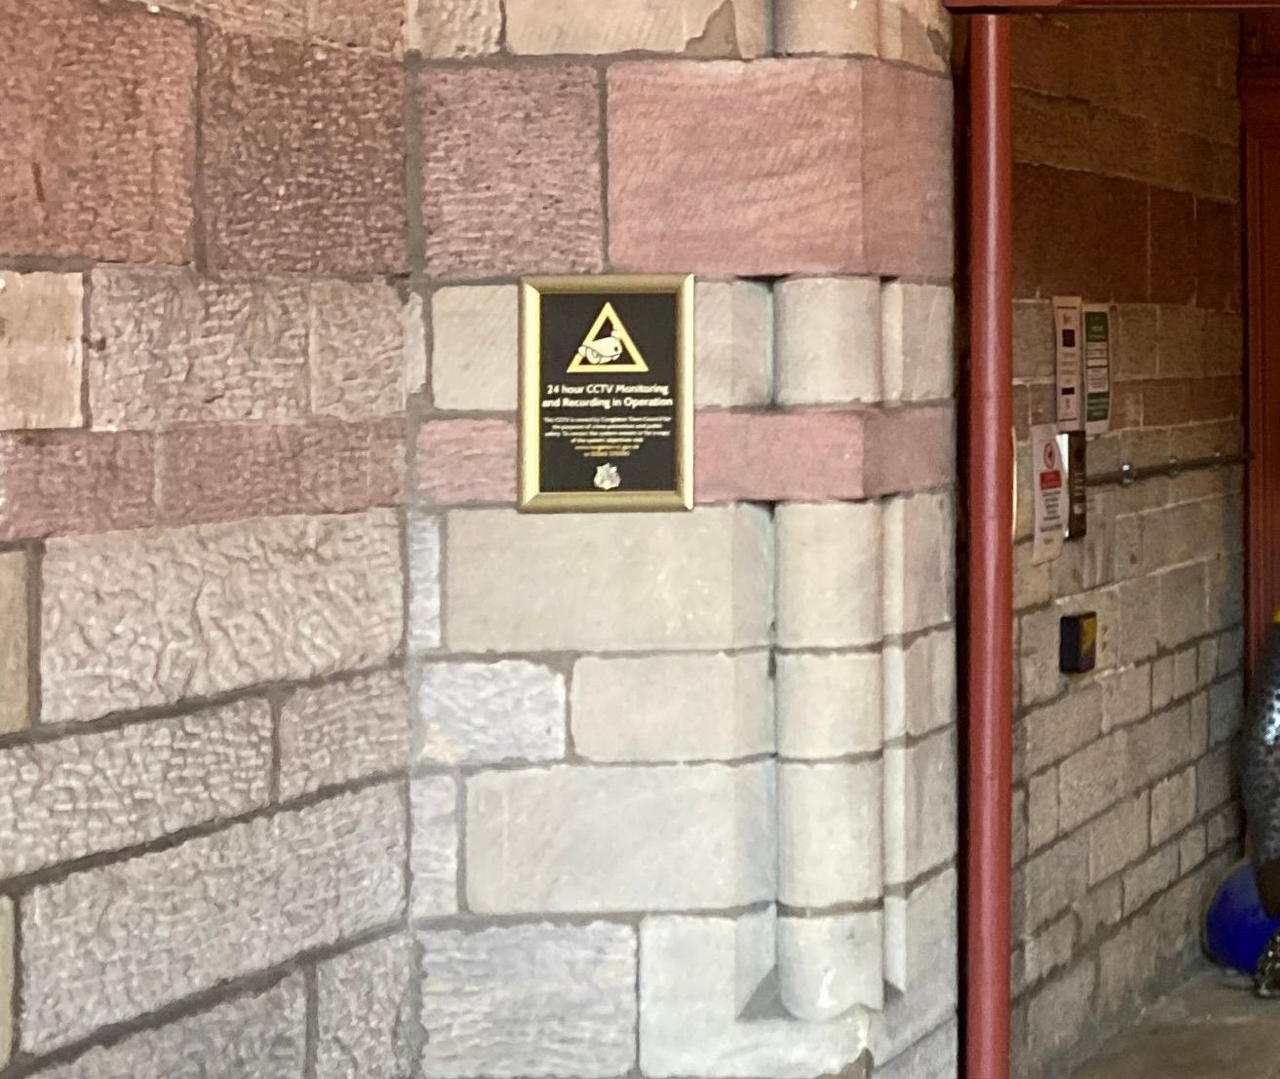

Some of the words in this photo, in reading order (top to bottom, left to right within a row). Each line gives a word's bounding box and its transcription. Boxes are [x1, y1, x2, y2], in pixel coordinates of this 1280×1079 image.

[547, 384, 559, 394] 24
[561, 384, 585, 394] hour
[586, 384, 614, 394] CCTV
[615, 384, 669, 396] Monitoring
[542, 398, 561, 407] and
[562, 397, 611, 409] Recording
[612, 397, 621, 407] in
[623, 396, 673, 409] Operation
